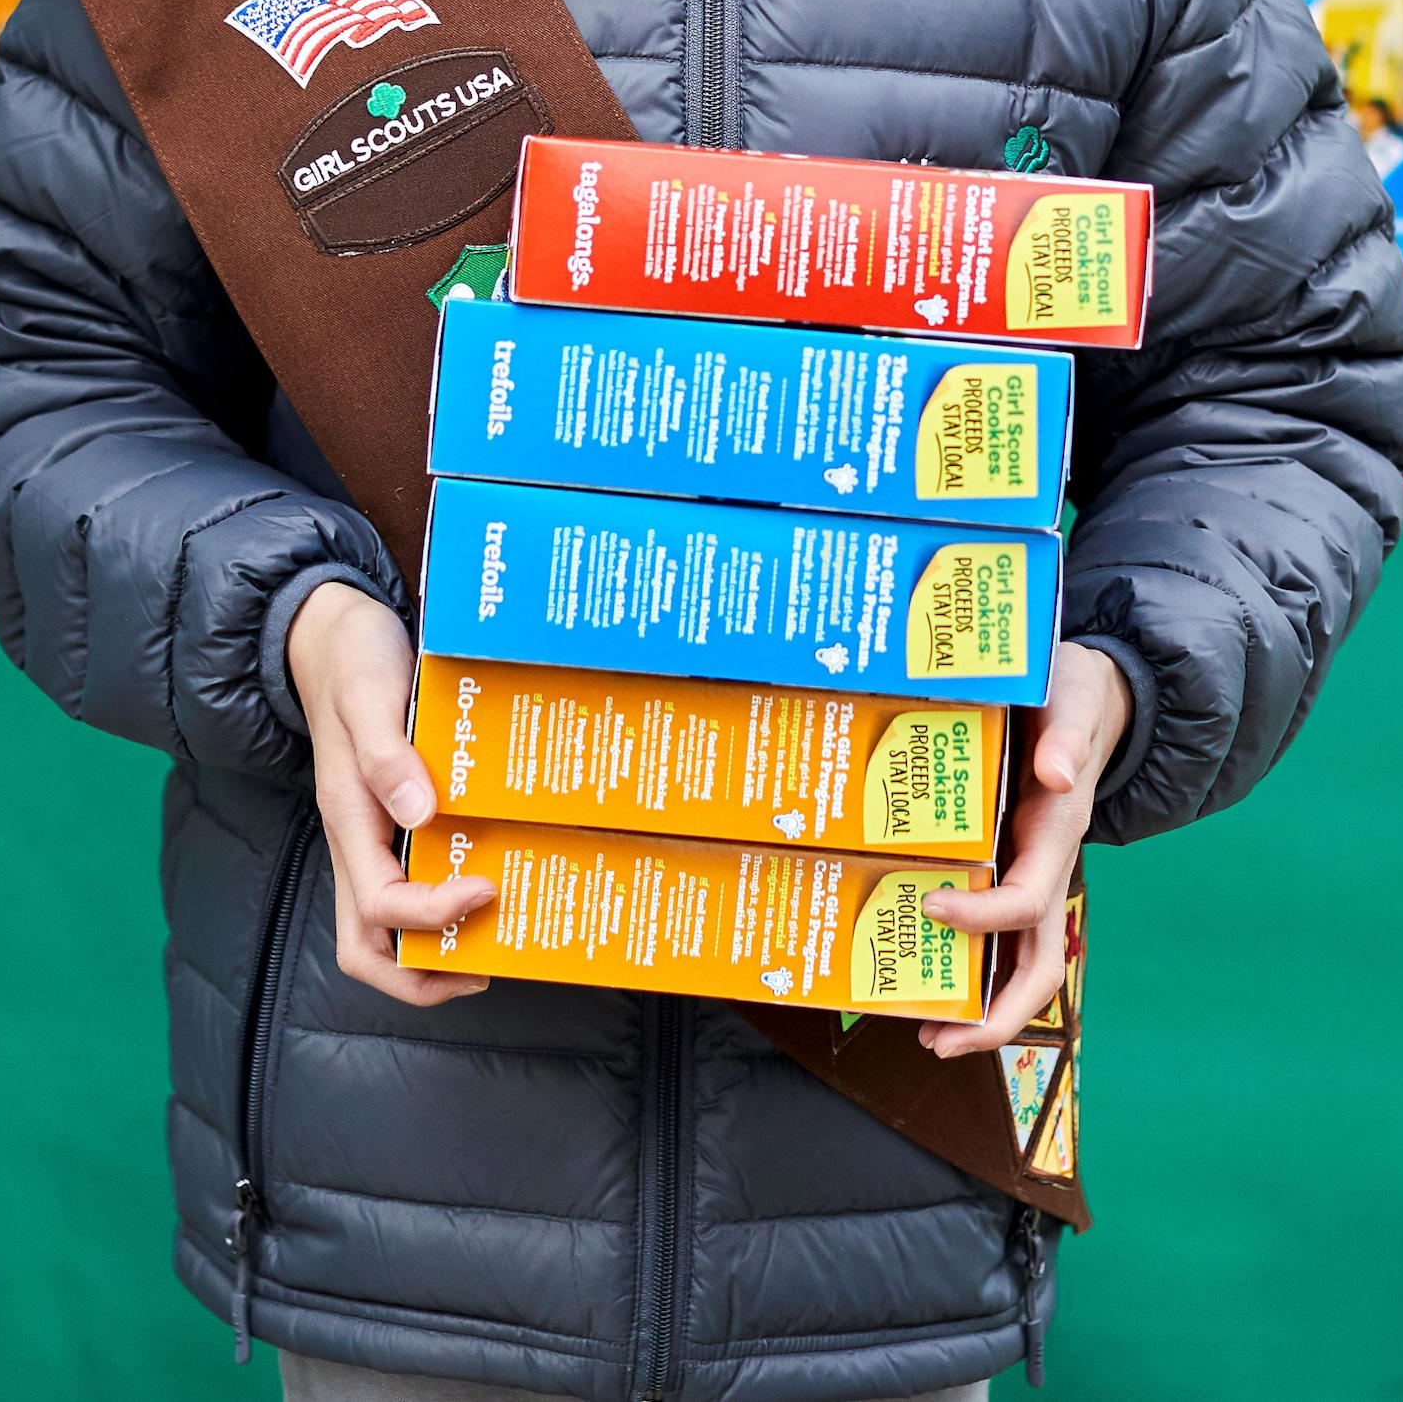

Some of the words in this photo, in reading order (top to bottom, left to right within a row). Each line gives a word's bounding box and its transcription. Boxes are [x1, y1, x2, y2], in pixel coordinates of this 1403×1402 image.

[293, 150, 356, 192] GIRL
[350, 92, 457, 163] SCOUTS
[456, 66, 514, 107] USA
[667, 191, 680, 245] Business
[963, 184, 980, 242] Cookie
[980, 185, 995, 218] The
[712, 203, 726, 244] People
[748, 198, 764, 276] Management
[800, 198, 813, 250] Decision
[847, 215, 858, 243] Goal
[977, 219, 993, 254] Girl
[1094, 203, 1112, 243] Girl
[664, 245, 676, 283] Ethics
[711, 243, 723, 278] Skills
[759, 223, 774, 265] Money
[1031, 233, 1050, 269] STAY
[1051, 207, 1073, 283] PROCEEDS
[794, 249, 809, 297] Making
[841, 243, 856, 286] Setting
[973, 255, 990, 304] Scout
[1096, 252, 1112, 314] Scout
[1033, 275, 1053, 320] LOCAL
[873, 354, 891, 412] Cookie
[891, 355, 907, 388] The
[887, 389, 904, 423] Girl
[1006, 374, 1024, 415] Girl
[942, 403, 961, 439] STAY
[962, 377, 983, 453] PROCEEDS
[883, 425, 900, 473] Scout
[944, 445, 963, 490] LOCAL
[1007, 423, 1023, 485] Scout
[864, 533, 882, 591] Cookie
[881, 534, 897, 567] The
[878, 568, 894, 603] Girl
[996, 553, 1013, 594] Girl
[932, 582, 951, 618] STAY
[952, 556, 973, 632] PROCEEDS
[874, 604, 891, 652] Scout
[934, 624, 953, 669] LOCAL
[997, 602, 1013, 663] Scout
[750, 694, 761, 718] five
[759, 696, 773, 737] Through
[777, 697, 788, 748] program
[804, 710, 814, 727] the
[806, 700, 813, 708] is
[838, 702, 854, 735] The
[528, 704, 541, 758] Business
[573, 717, 586, 757] People
[659, 713, 672, 764] Decision
[706, 730, 717, 758] Goal
[745, 718, 757, 772] essential
[759, 738, 769, 749] it,
[786, 699, 801, 791] entrepreneurial
[800, 727, 813, 762] largest
[820, 701, 838, 758] Cookie
[952, 721, 969, 761] Girl
[608, 713, 624, 789] Management
[619, 737, 633, 778] Money
[757, 750, 767, 773] girls
[775, 760, 785, 778] the
[776, 749, 786, 761] in
[835, 736, 851, 770] Girl
[888, 749, 907, 785] STAY
[908, 724, 929, 799] PROCEEDS
[524, 758, 537, 795] Ethics
[571, 756, 583, 790] Skills
[652, 763, 668, 810] Making
[700, 758, 715, 800] Setting
[742, 771, 754, 806] skills:
[755, 773, 766, 800] learn
[798, 761, 809, 798] girl-led
[772, 778, 782, 809] world.
[831, 771, 847, 819] Scout
[890, 791, 910, 835] LOCAL
[953, 769, 969, 830] Scout
[739, 853, 751, 876] five
[748, 855, 762, 895] Through
[766, 856, 777, 905] program
[793, 868, 803, 885] the
[795, 858, 802, 867] is
[826, 861, 842, 893] The
[518, 860, 532, 913] Business
[563, 873, 577, 913] People
[649, 870, 663, 921] Decision
[695, 888, 707, 915] Goal
[734, 876, 746, 929] essential
[748, 896, 758, 906] it,
[775, 858, 790, 948] entrepreneurial
[789, 886, 802, 920] largest
[809, 860, 827, 916] Cookie
[598, 869, 615, 945] Management
[608, 894, 624, 934] Money
[746, 907, 756, 930] girls
[763, 918, 773, 936] the
[765, 907, 774, 918] in
[823, 894, 839, 928] Girl
[876, 908, 895, 944] STAY
[896, 883, 916, 957] PROCEEDS
[514, 913, 527, 950] Ethics
[561, 912, 574, 946] Skills
[642, 920, 657, 966] Making
[689, 915, 704, 957] Setting
[730, 928, 743, 963] skills:
[744, 930, 755, 957] learn
[786, 919, 798, 956] girl-led
[760, 935, 770, 966] world.
[818, 929, 835, 976] Scout
[940, 928, 955, 988] Scout
[878, 949, 896, 993] LOCAL
